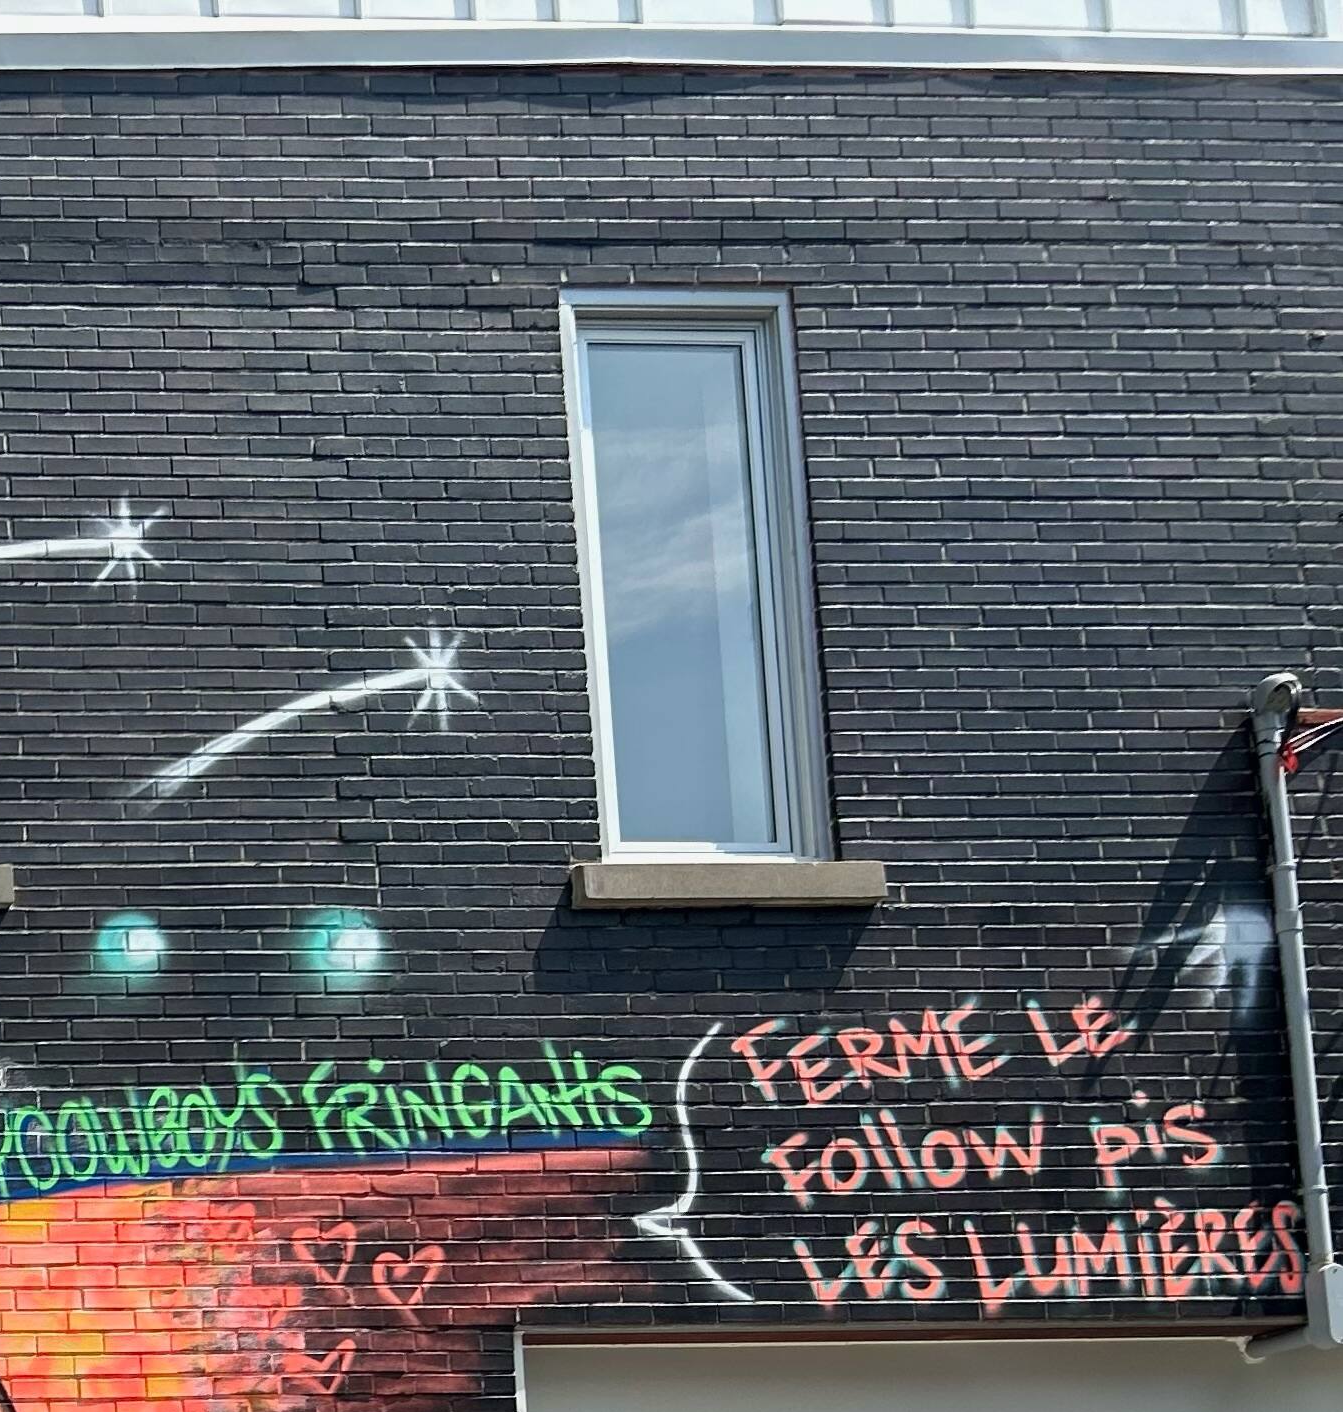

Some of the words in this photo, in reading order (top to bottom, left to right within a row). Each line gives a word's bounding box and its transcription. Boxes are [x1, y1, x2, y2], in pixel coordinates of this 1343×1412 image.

[731, 998, 1013, 1106] FERME
[1027, 995, 1133, 1067] LE
[12, 1068, 293, 1192] COWBOYS
[793, 1219, 949, 1310] LES
